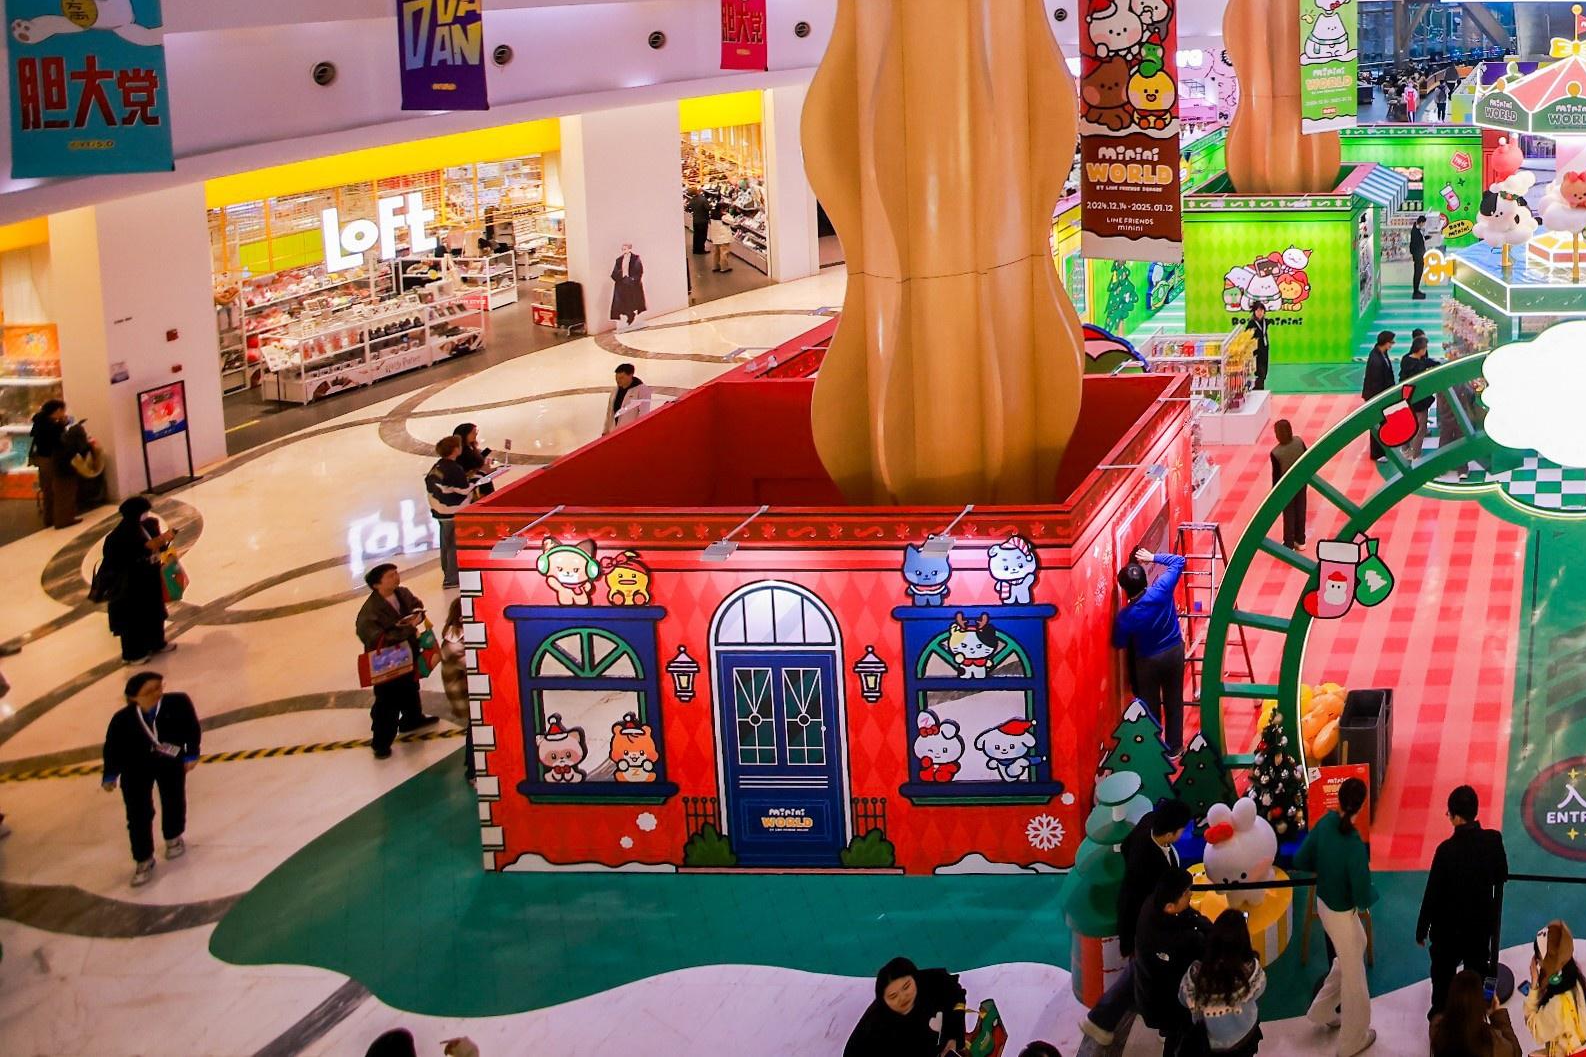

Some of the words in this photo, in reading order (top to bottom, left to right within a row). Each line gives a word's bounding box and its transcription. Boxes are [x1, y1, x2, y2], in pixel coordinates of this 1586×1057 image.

[723, 2, 765, 44] 胆大党
[1305, 75, 1353, 91] WORLD
[18, 55, 161, 131] 胆大党
[1490, 99, 1513, 110] minini
[1484, 107, 1518, 122] WORLD
[1098, 145, 1160, 162] minini
[1085, 162, 1173, 186] WORLD
[1117, 224, 1144, 232] minini
[1123, 217, 1154, 225] FRIENDS
[768, 808, 806, 817] minini
[761, 816, 814, 829] WORLD
